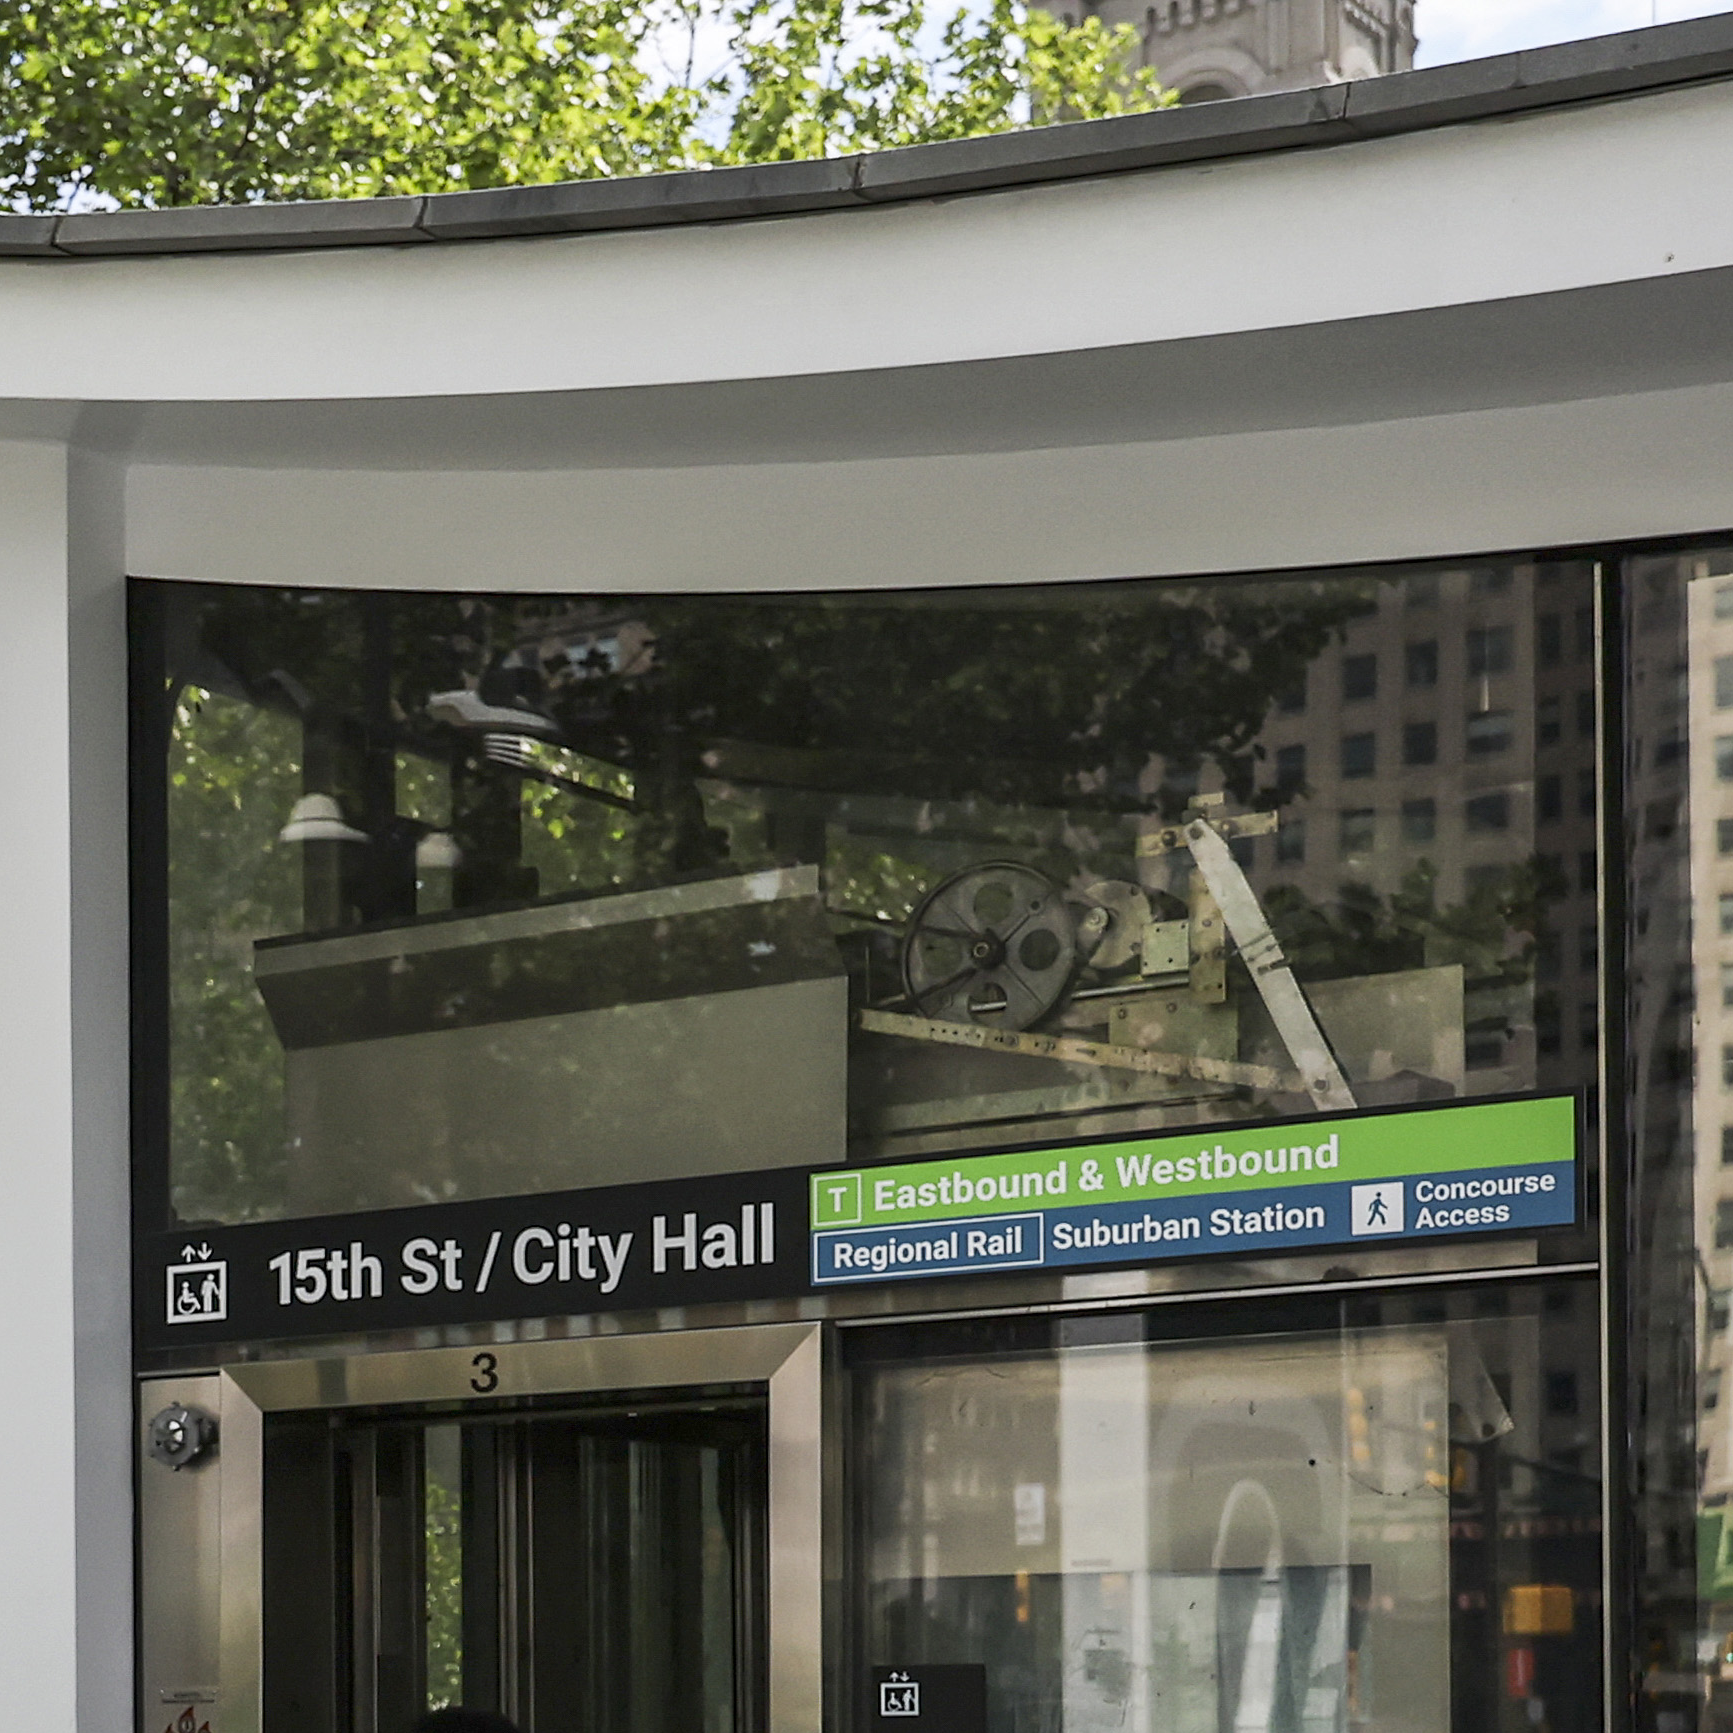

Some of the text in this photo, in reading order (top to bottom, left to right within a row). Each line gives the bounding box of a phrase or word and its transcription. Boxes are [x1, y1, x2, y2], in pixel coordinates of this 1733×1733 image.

[827, 1133, 1339, 1213] T Eastbound & Westbound
[1415, 1171, 1557, 1204] Concourse
[833, 1203, 1326, 1272] Regional Rail Suburban Station
[1415, 1202, 1511, 1230] Access
[269, 1202, 775, 1305] 15th St / City Hall
[469, 1352, 499, 1394] 3
